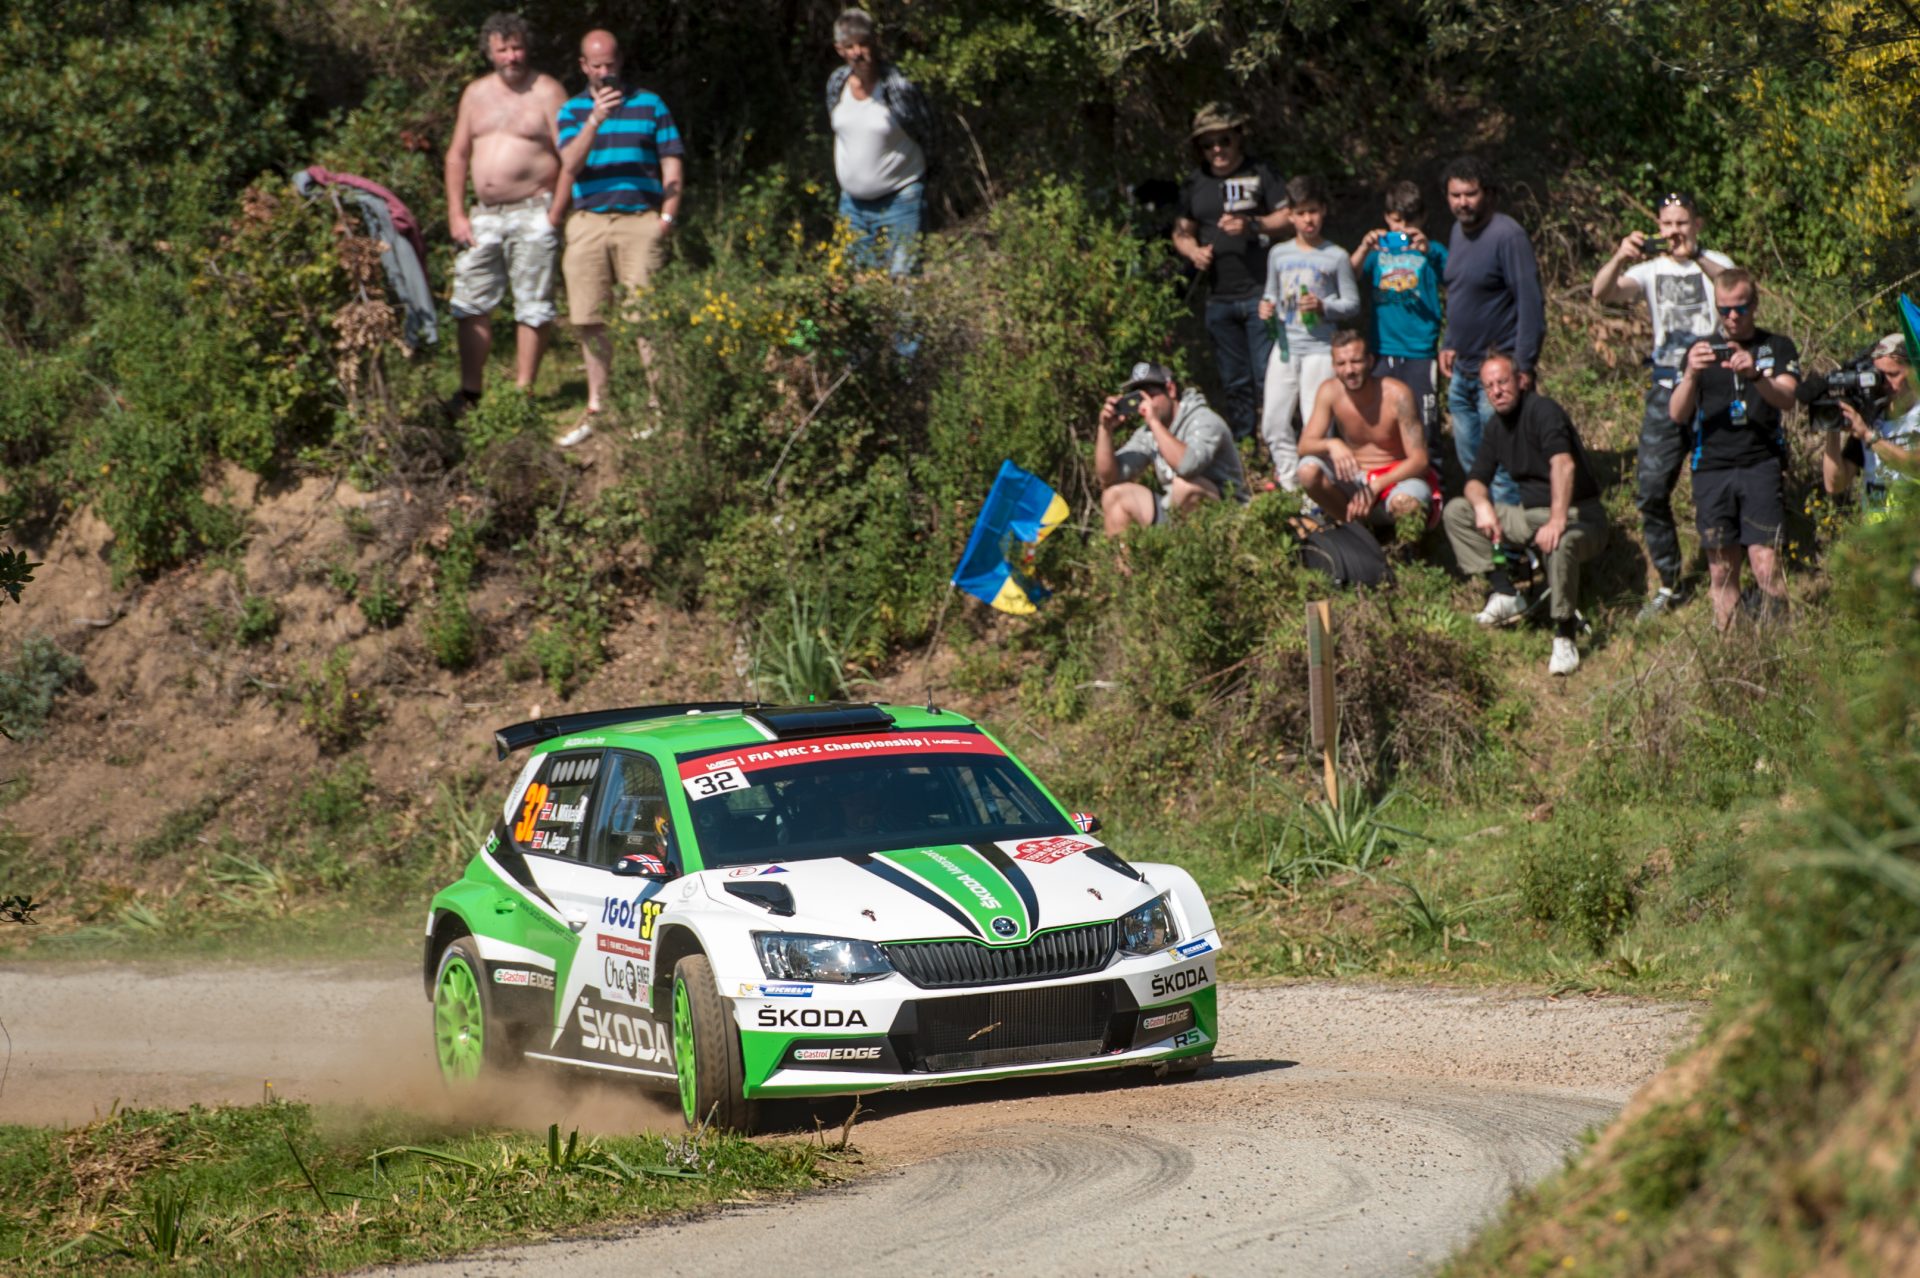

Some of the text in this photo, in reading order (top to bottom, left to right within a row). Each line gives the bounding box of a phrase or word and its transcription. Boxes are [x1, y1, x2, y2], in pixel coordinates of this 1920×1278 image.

[747, 752, 775, 763] FIA
[774, 746, 809, 758] WRC
[810, 744, 822, 753] 2
[823, 737, 923, 751] Championship
[694, 771, 739, 795] 32
[514, 782, 550, 842] 32
[956, 873, 1003, 910] ŠKODA
[602, 896, 636, 930] IGOL
[503, 971, 555, 991] Castrol EDGE
[604, 956, 625, 990] Che
[1151, 966, 1209, 998] ŠKODA
[765, 986, 814, 994] MICHELIN
[758, 1005, 868, 1027] ŠKODA
[1166, 1008, 1190, 1025] EDGE
[577, 996, 673, 1067] ŠKODA
[1174, 1030, 1201, 1048] R5
[803, 1046, 883, 1060] Castrol EDGE
